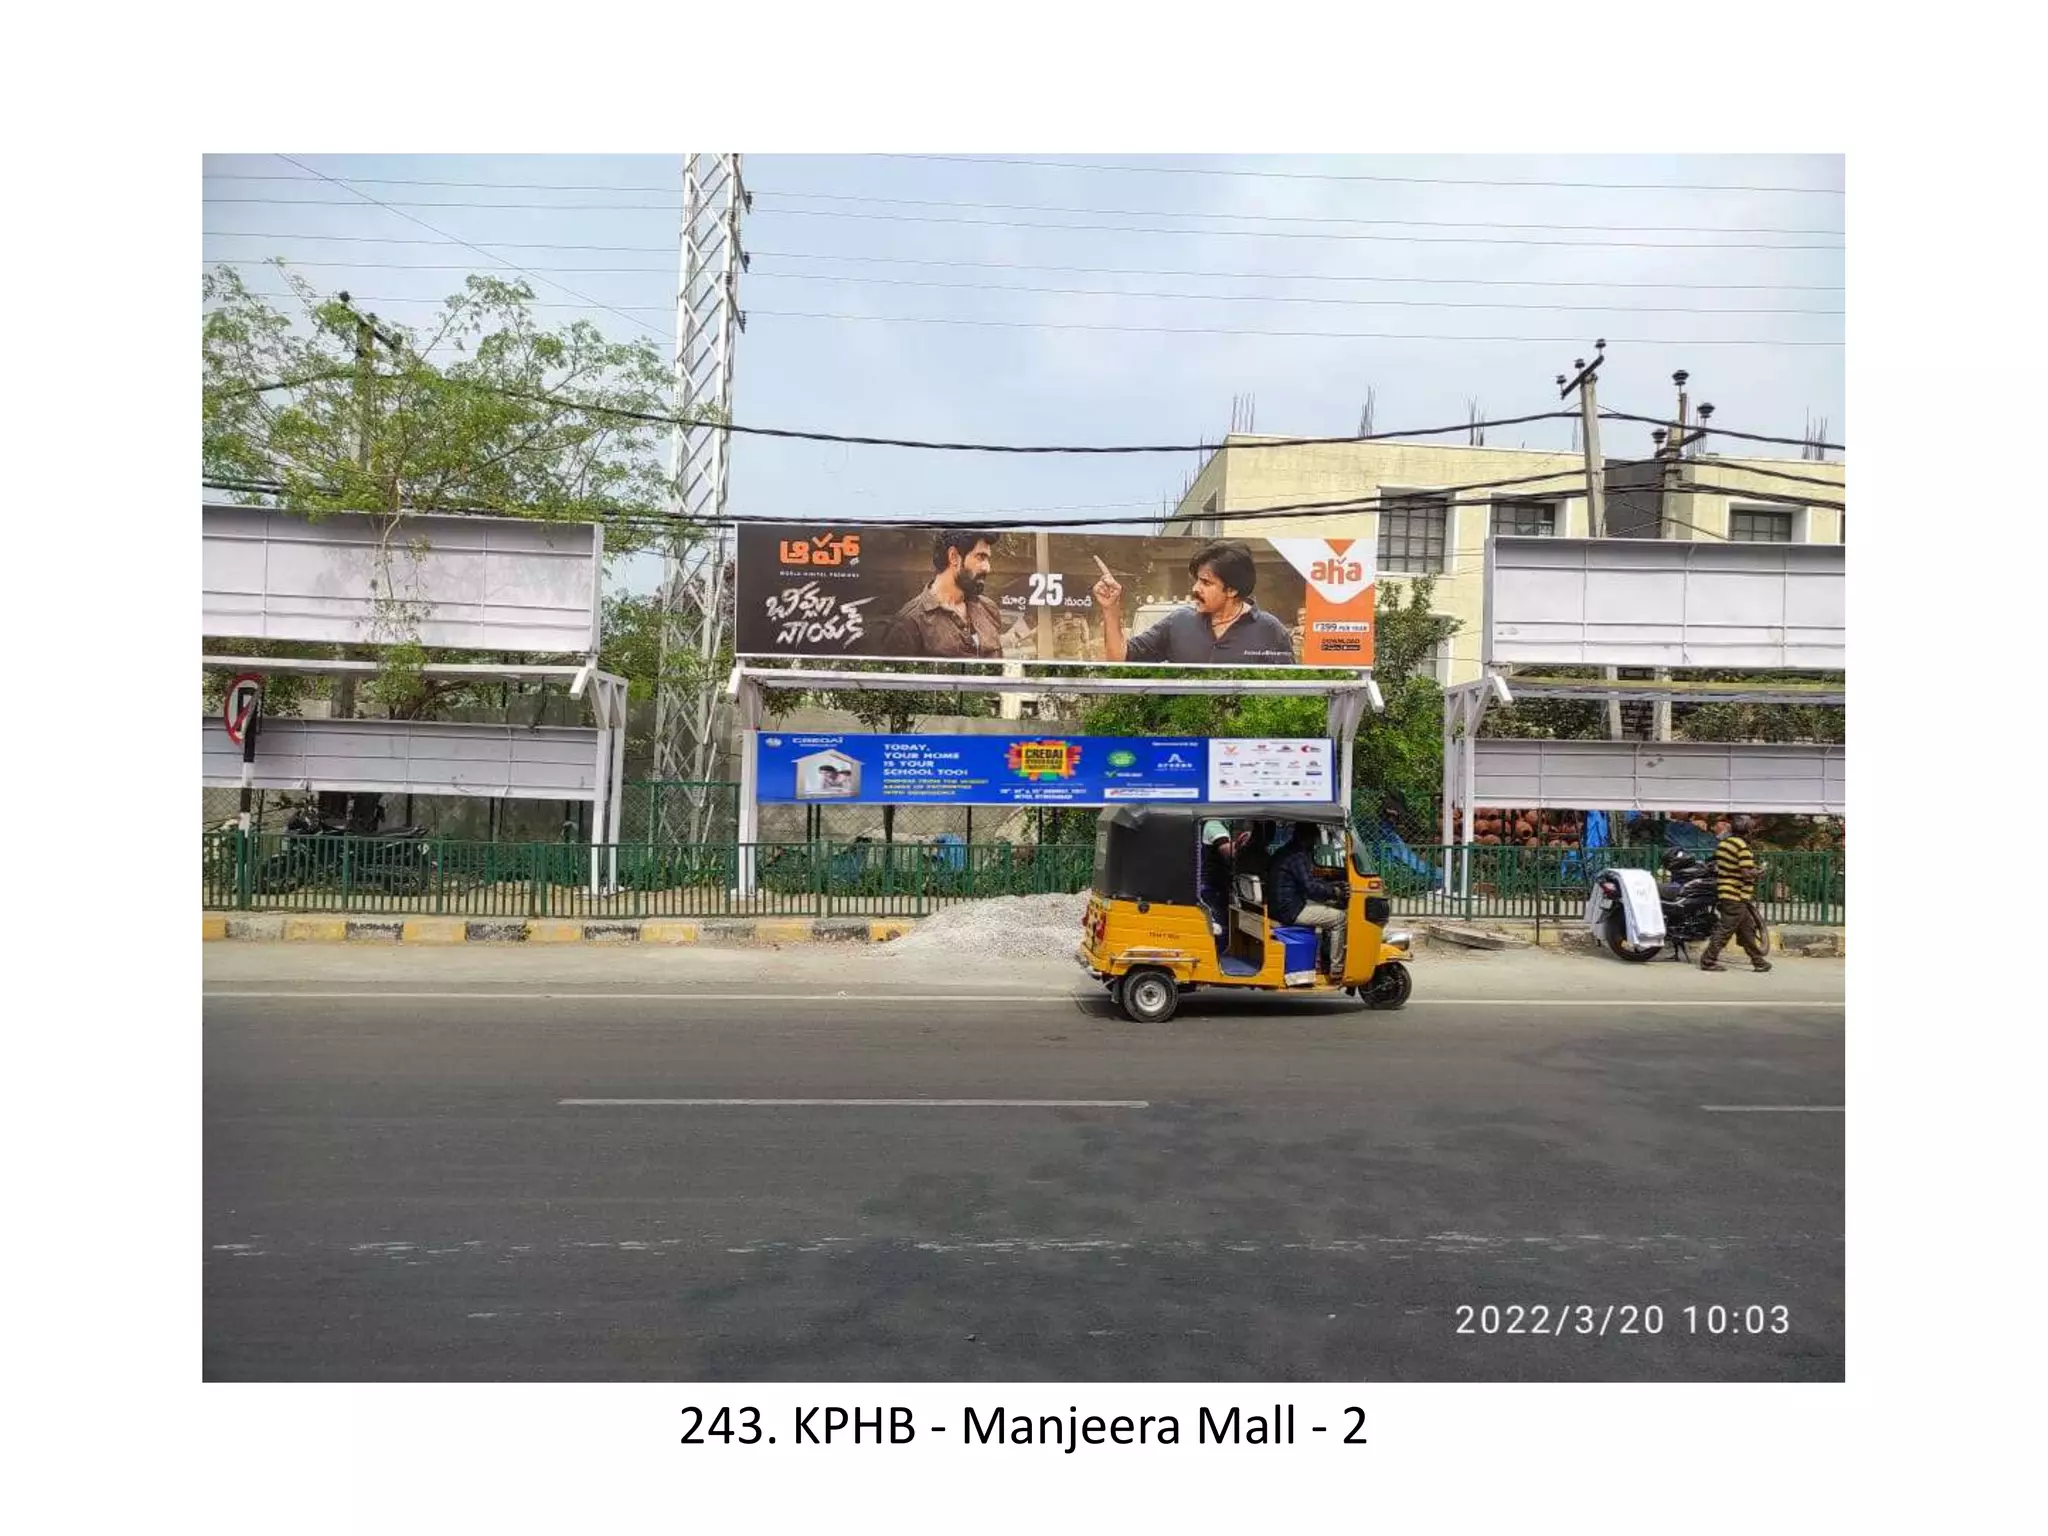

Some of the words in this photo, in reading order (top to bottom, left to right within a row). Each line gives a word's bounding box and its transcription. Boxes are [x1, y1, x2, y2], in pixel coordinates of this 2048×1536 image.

[1310, 557, 1362, 584] aha
[1029, 573, 1063, 606] 25
[883, 752, 919, 760] YOUR
[923, 752, 960, 760] HOME
[884, 760, 895, 768] IS
[900, 760, 935, 768] YOUR
[883, 768, 933, 776] SCHOOL
